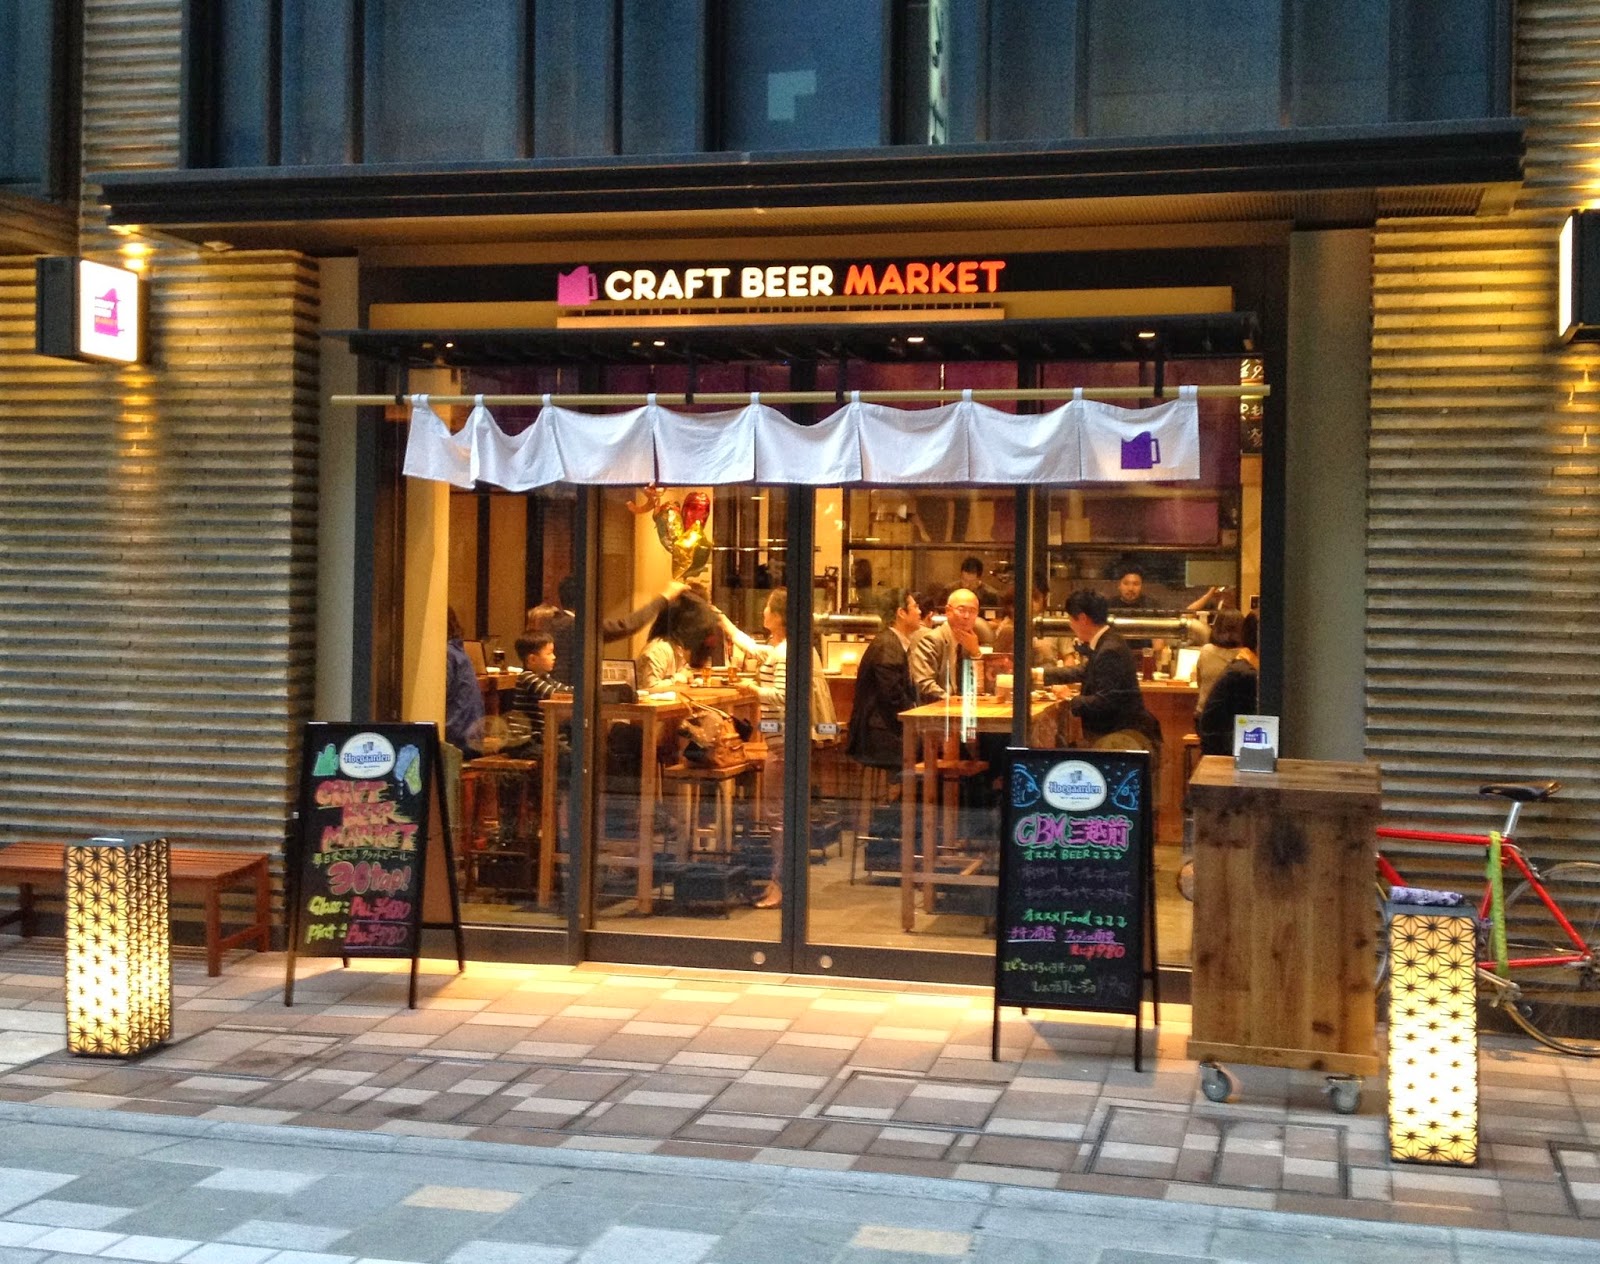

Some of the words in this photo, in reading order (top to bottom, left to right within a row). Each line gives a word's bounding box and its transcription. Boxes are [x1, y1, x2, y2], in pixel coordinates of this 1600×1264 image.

[605, 268, 730, 301] CRAFT
[740, 265, 833, 298] BEER
[843, 261, 1006, 295] MARKET
[344, 752, 391, 764] Hoegaarden
[1048, 781, 1102, 795] Hoegaarden
[1015, 813, 1067, 847] CBM
[1061, 849, 1090, 860] BEER
[1062, 910, 1092, 926] Food
